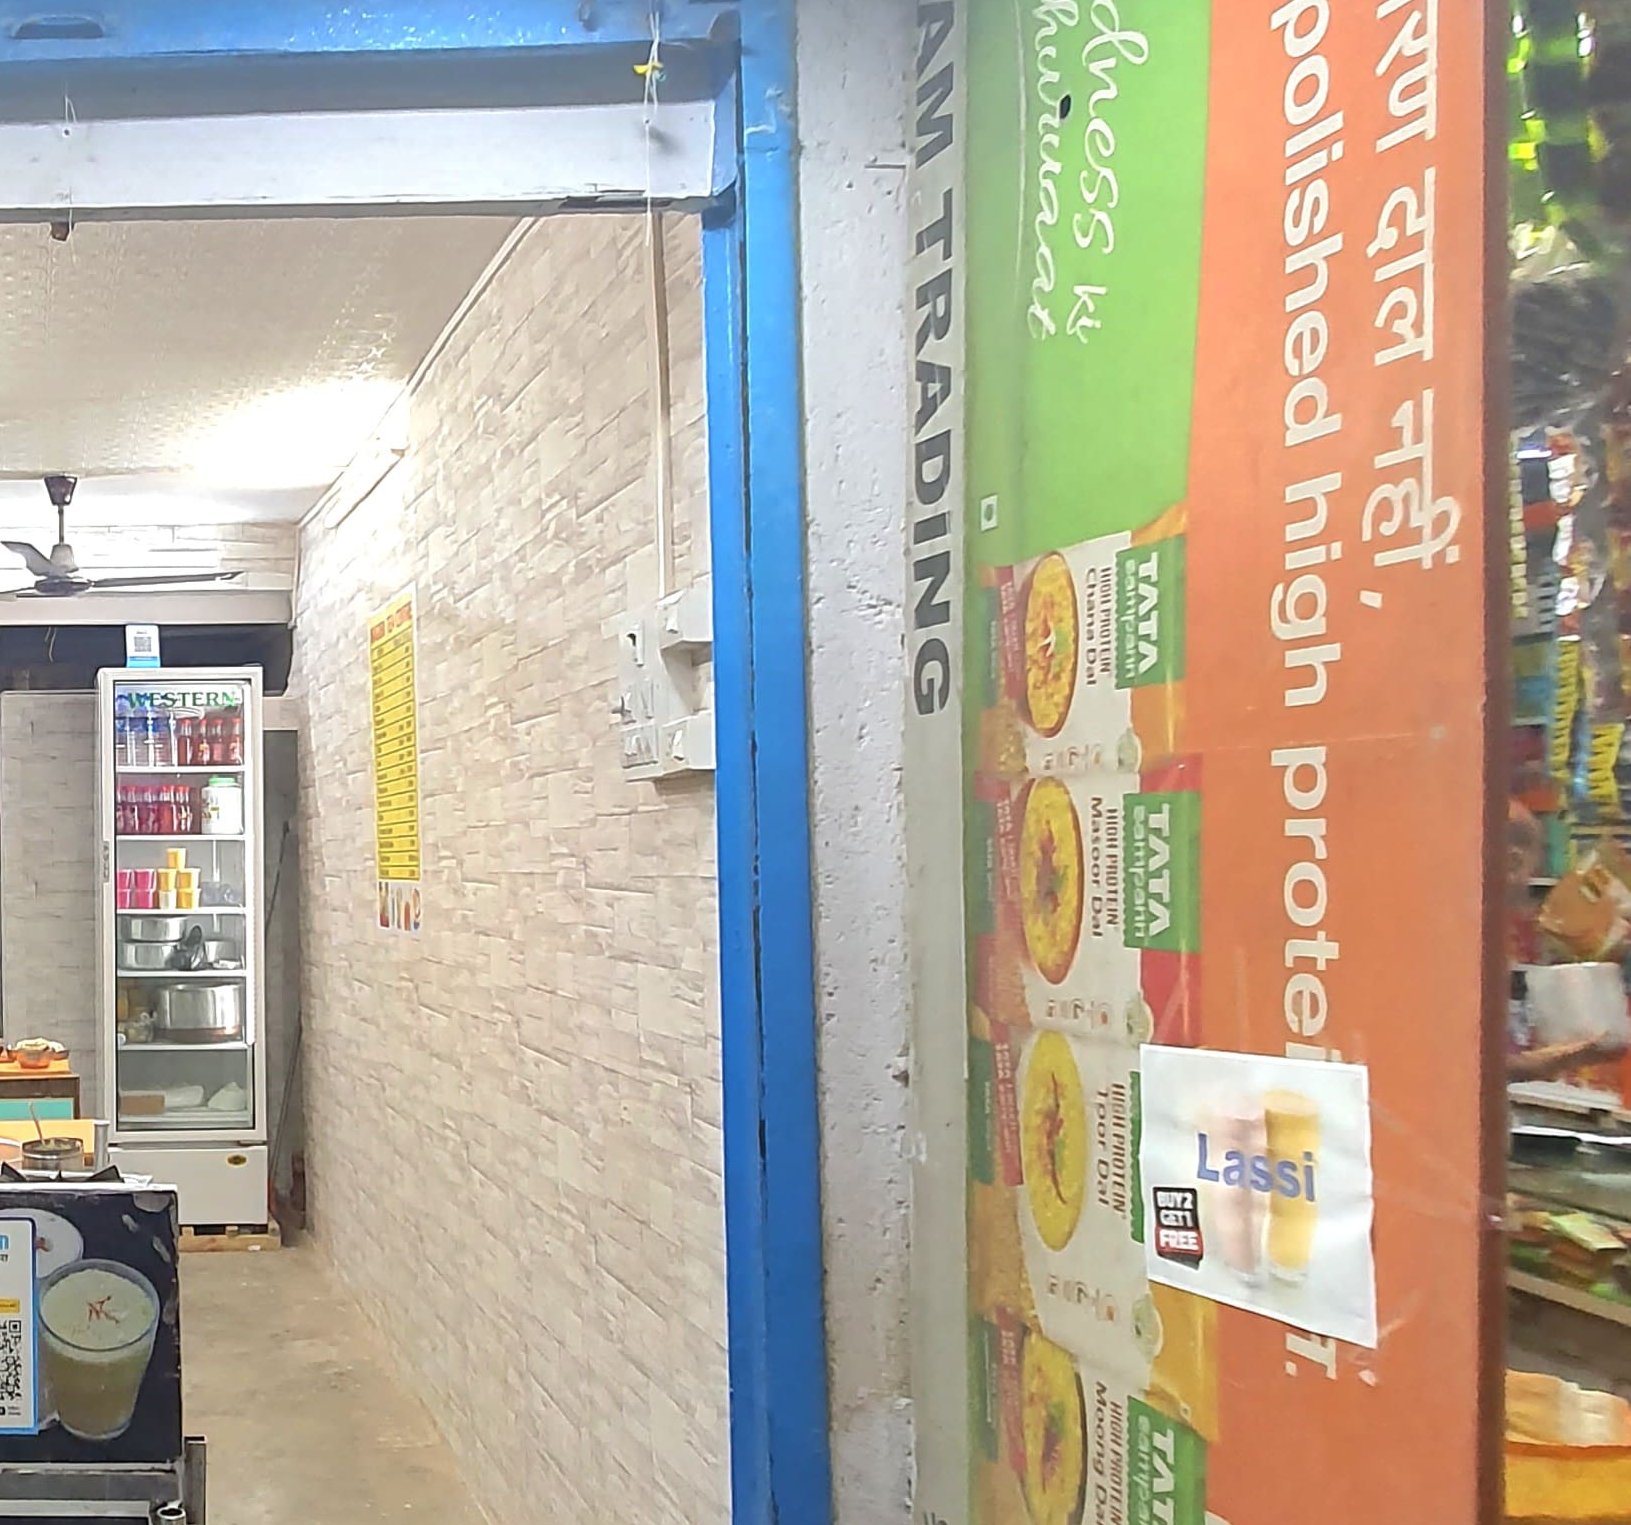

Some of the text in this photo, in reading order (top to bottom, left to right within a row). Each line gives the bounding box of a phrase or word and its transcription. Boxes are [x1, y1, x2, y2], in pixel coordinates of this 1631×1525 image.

[1367, 165, 1437, 368] दाल
[911, 186, 955, 717] TRADING
[1084, 567, 1098, 686] Chana Dal
[1136, 551, 1159, 675] TATA
[1270, 471, 1344, 709] high
[127, 690, 238, 709] WESTERN
[1090, 796, 1104, 938] Masoor Dal
[1148, 802, 1171, 937] TATA
[1270, 745, 1343, 1062] protei
[1096, 1158, 1109, 1208] Dal
[1196, 1132, 1317, 1203] Lassi
[1158, 1229, 1200, 1251] FREE
[1092, 1380, 1108, 1477] Moong
[1108, 1449, 1123, 1525] PROTEIN
